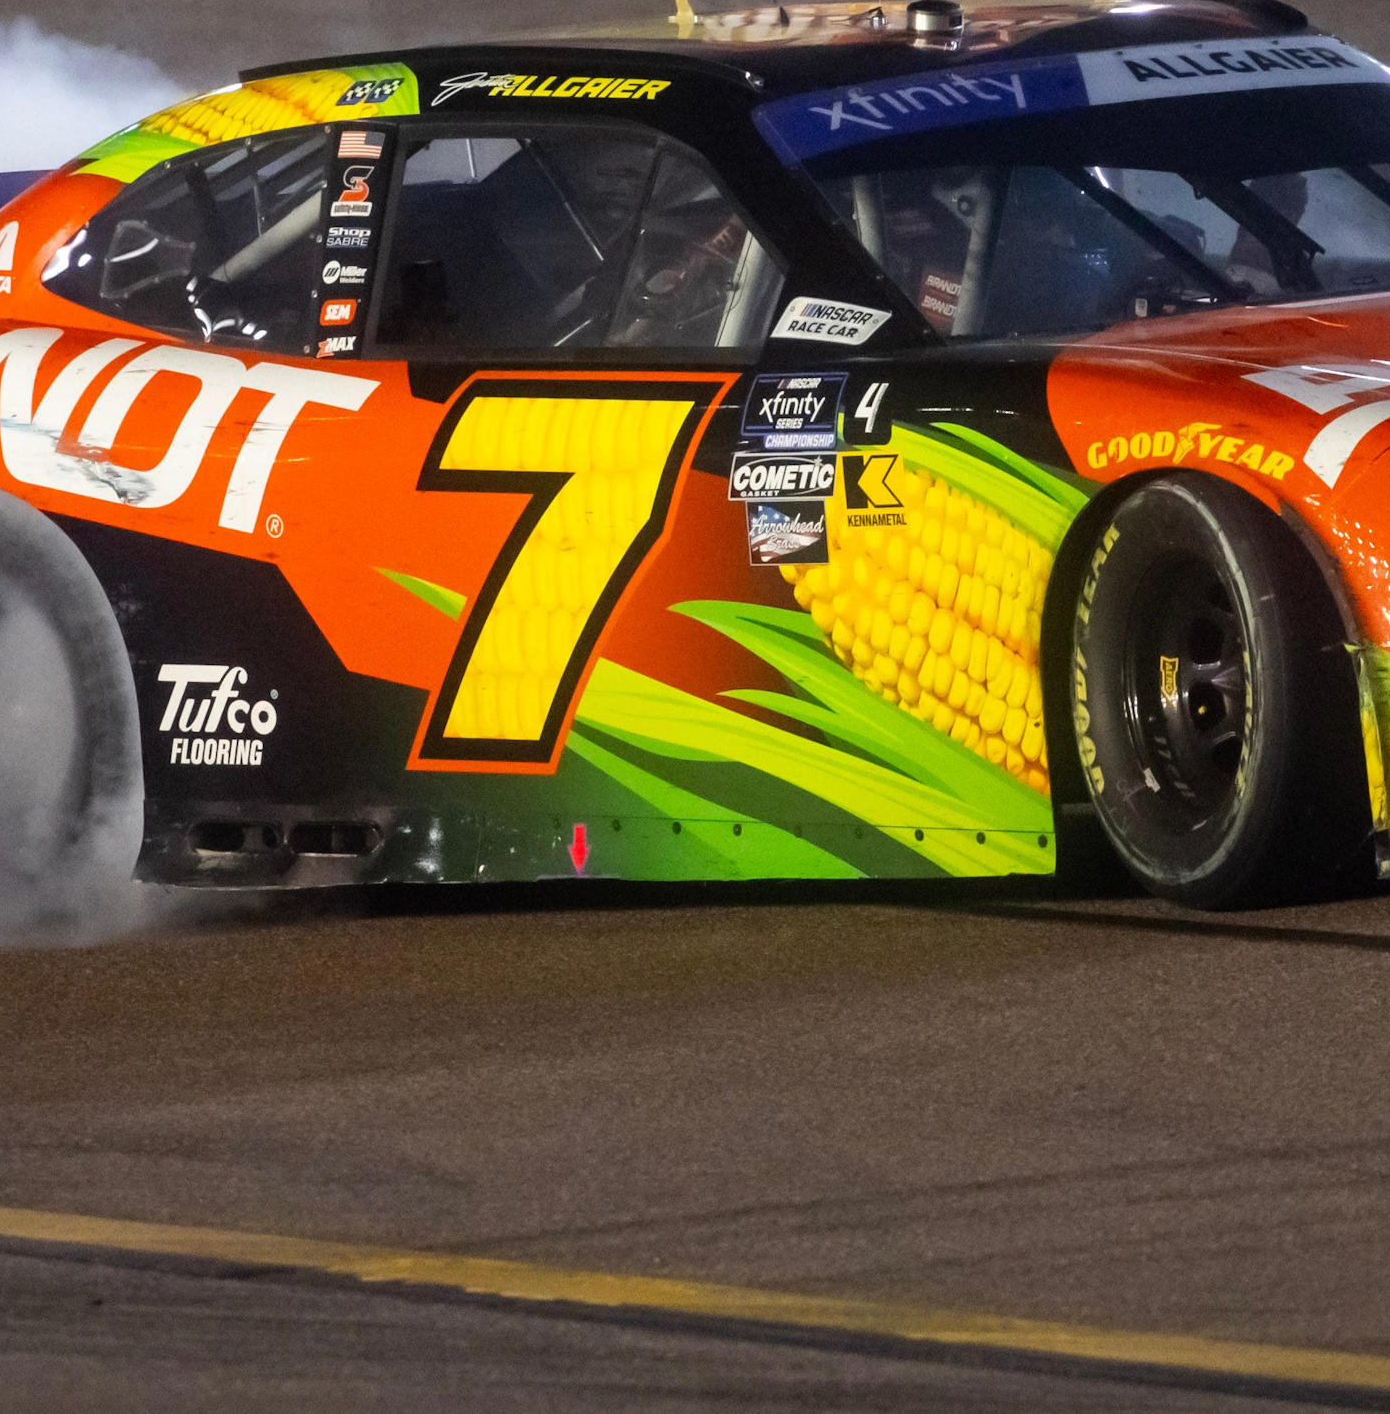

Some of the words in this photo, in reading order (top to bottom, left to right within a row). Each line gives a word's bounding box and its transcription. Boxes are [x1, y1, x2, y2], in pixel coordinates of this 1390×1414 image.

[1123, 47, 1361, 82] ALLGAIER
[488, 74, 672, 101] ALLGAIER
[810, 71, 1027, 131] xfinity
[326, 238, 369, 247] SABRE
[329, 227, 372, 238] Shop
[324, 304, 351, 321] SEM
[812, 304, 873, 326] NASCAR
[787, 320, 823, 334] RACE
[827, 324, 859, 338] CAR
[759, 390, 826, 423] xfinity
[854, 382, 889, 433] 4
[775, 418, 804, 430] SERIES
[765, 434, 835, 449] CHAMPIONSHIP
[733, 461, 835, 492] COMETIC
[750, 513, 825, 536] Arrowhead
[847, 513, 907, 528] KENNAMETAL
[417, 380, 706, 763] 7
[157, 664, 278, 736] Tufco
[169, 738, 264, 766] FLOORING
